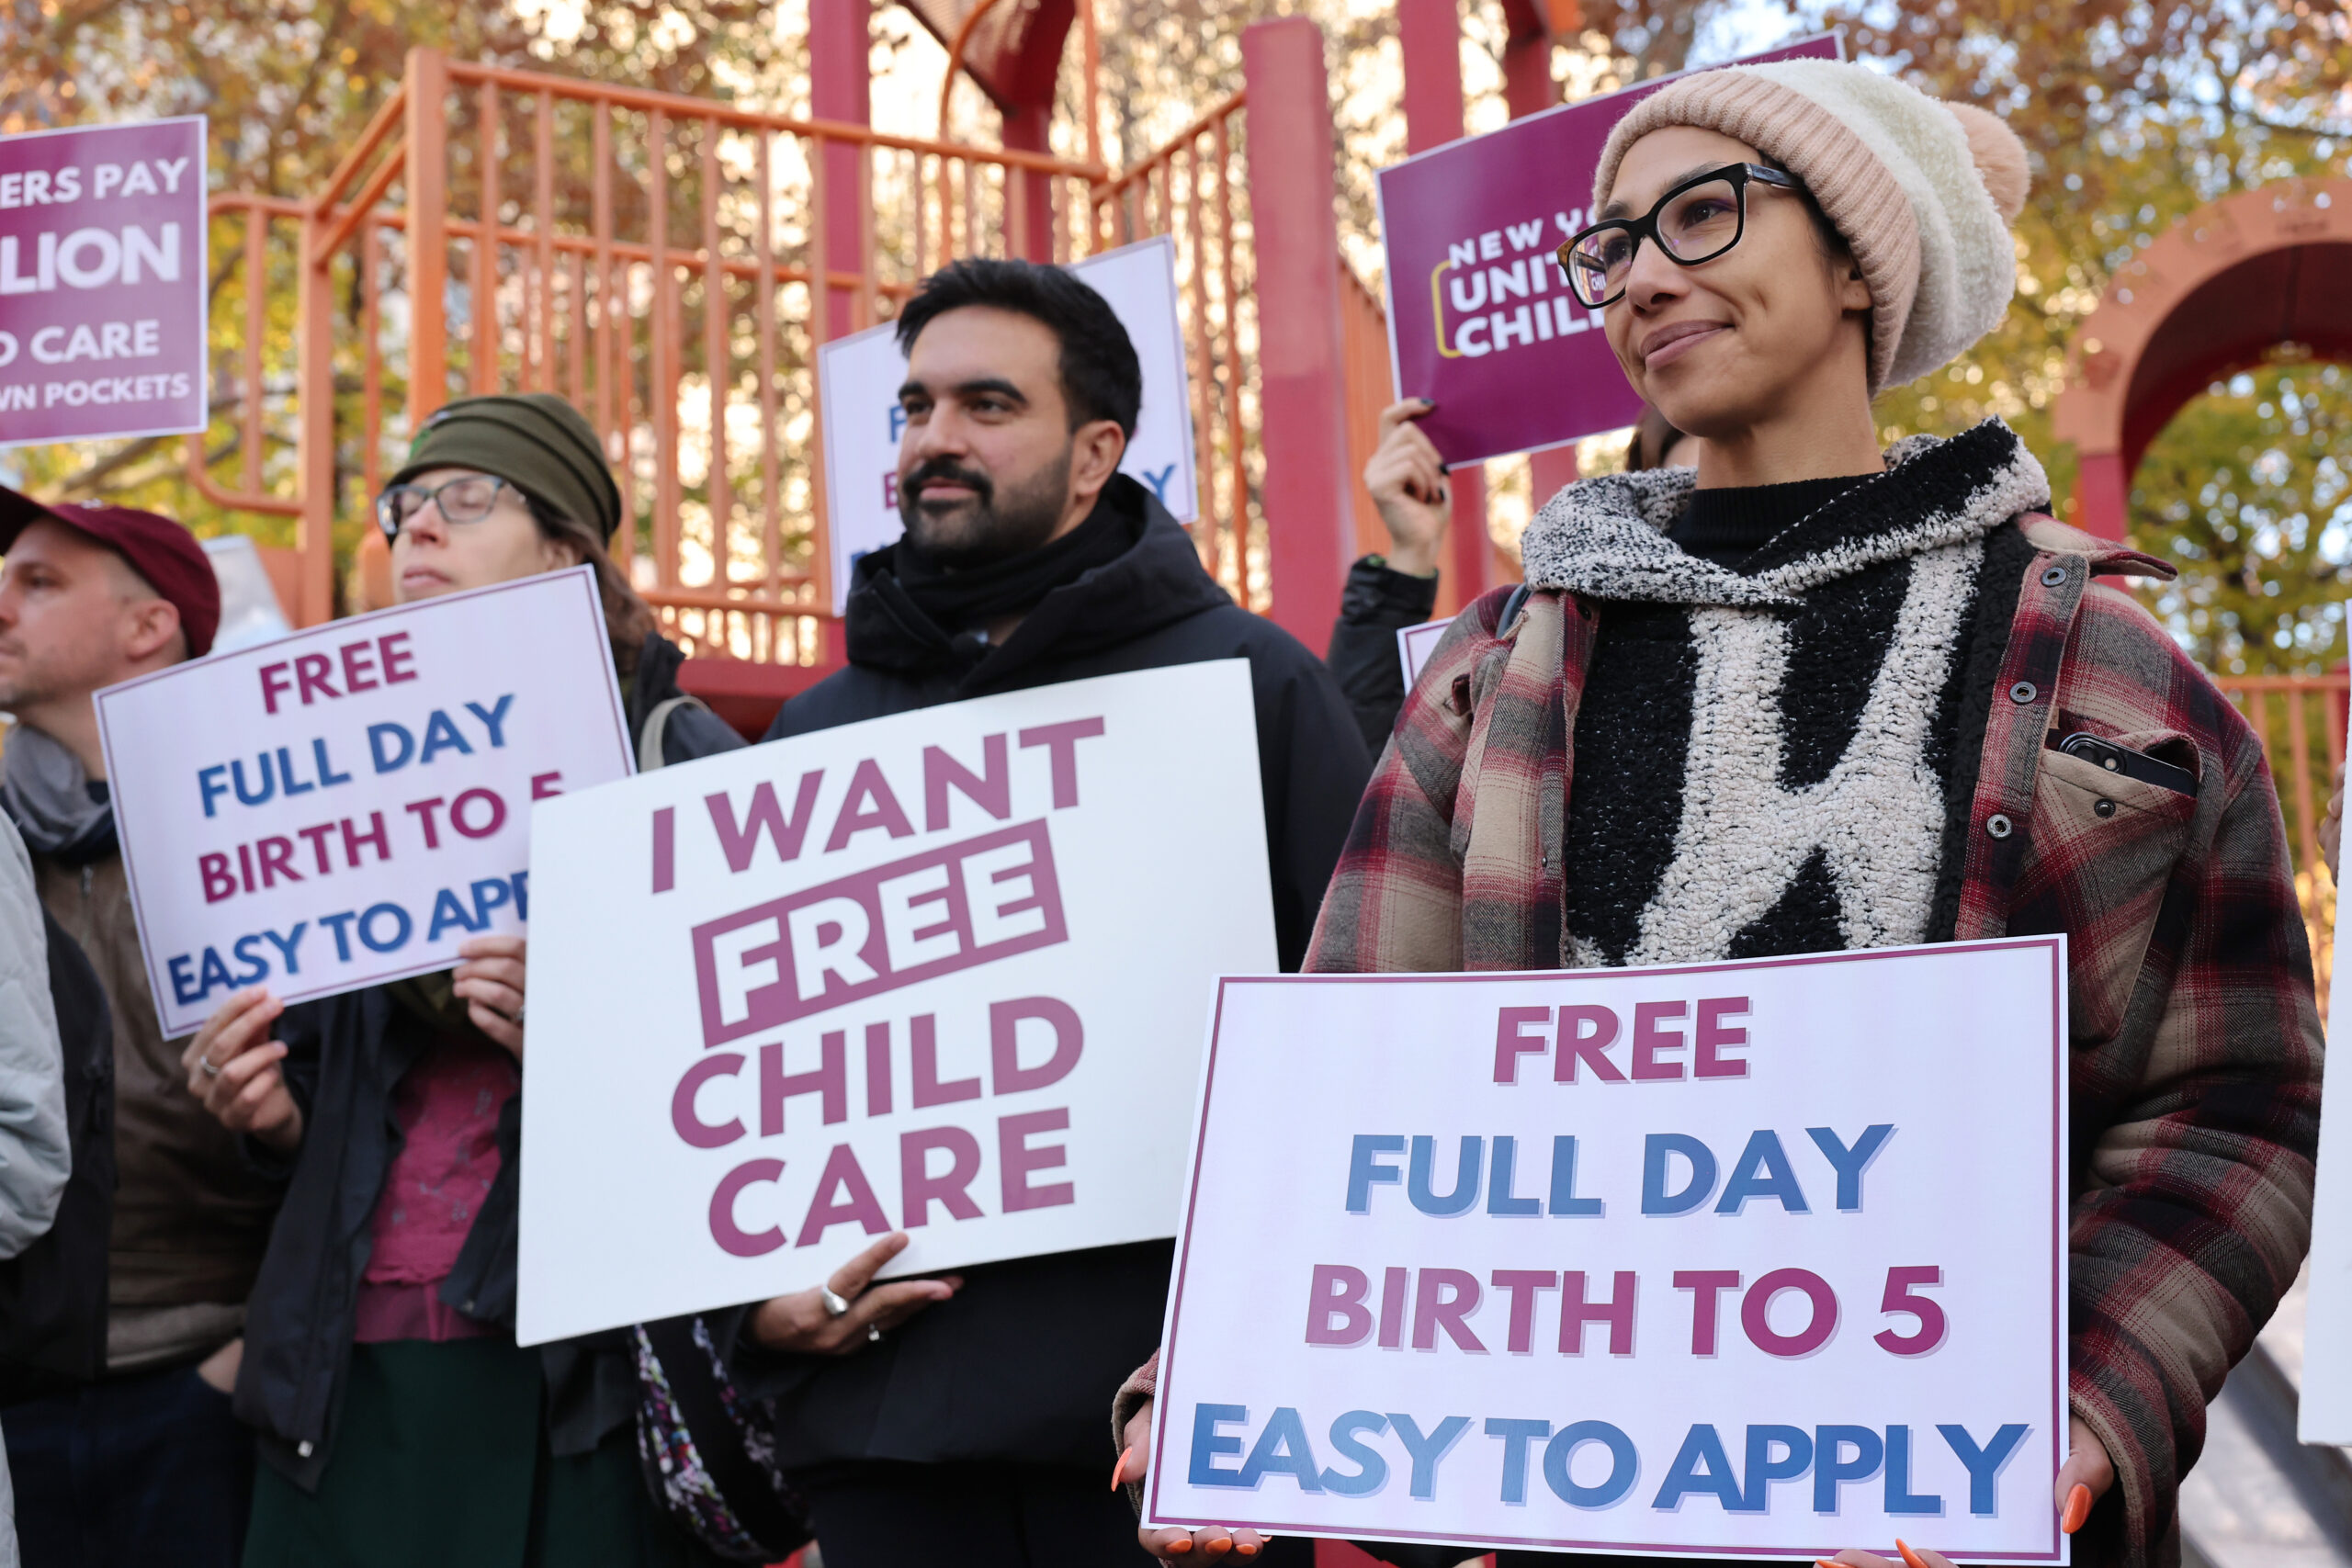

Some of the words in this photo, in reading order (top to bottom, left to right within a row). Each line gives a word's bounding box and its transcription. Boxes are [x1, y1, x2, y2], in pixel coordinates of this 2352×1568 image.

[95, 156, 189, 199] PAY
[1449, 218, 1543, 270] NEW
[30, 320, 160, 364] CARE
[44, 371, 191, 408] POCKETS
[259, 631, 418, 715] FREE
[198, 738, 352, 818] FULL
[368, 694, 514, 774] DAY
[652, 806, 675, 895] I
[705, 716, 1106, 874] WANT
[198, 810, 391, 905] BIRTH
[405, 787, 508, 850] TO
[166, 921, 307, 1007] EASY
[318, 902, 413, 963] TO
[711, 839, 1046, 1027] FREE
[672, 996, 1085, 1150] CHILD
[1493, 996, 1753, 1087] FREE
[708, 1107, 1076, 1258] CARE
[1344, 1134, 1607, 1219] FULL
[1640, 1122, 1898, 1218] DAY
[1305, 1263, 1641, 1360] BIRTH
[1671, 1267, 1843, 1361] TO
[1872, 1264, 1951, 1360] 5
[1187, 1402, 1473, 1501] EASY
[1484, 1417, 1643, 1512] TO
[1650, 1421, 2036, 1520] APPLY
